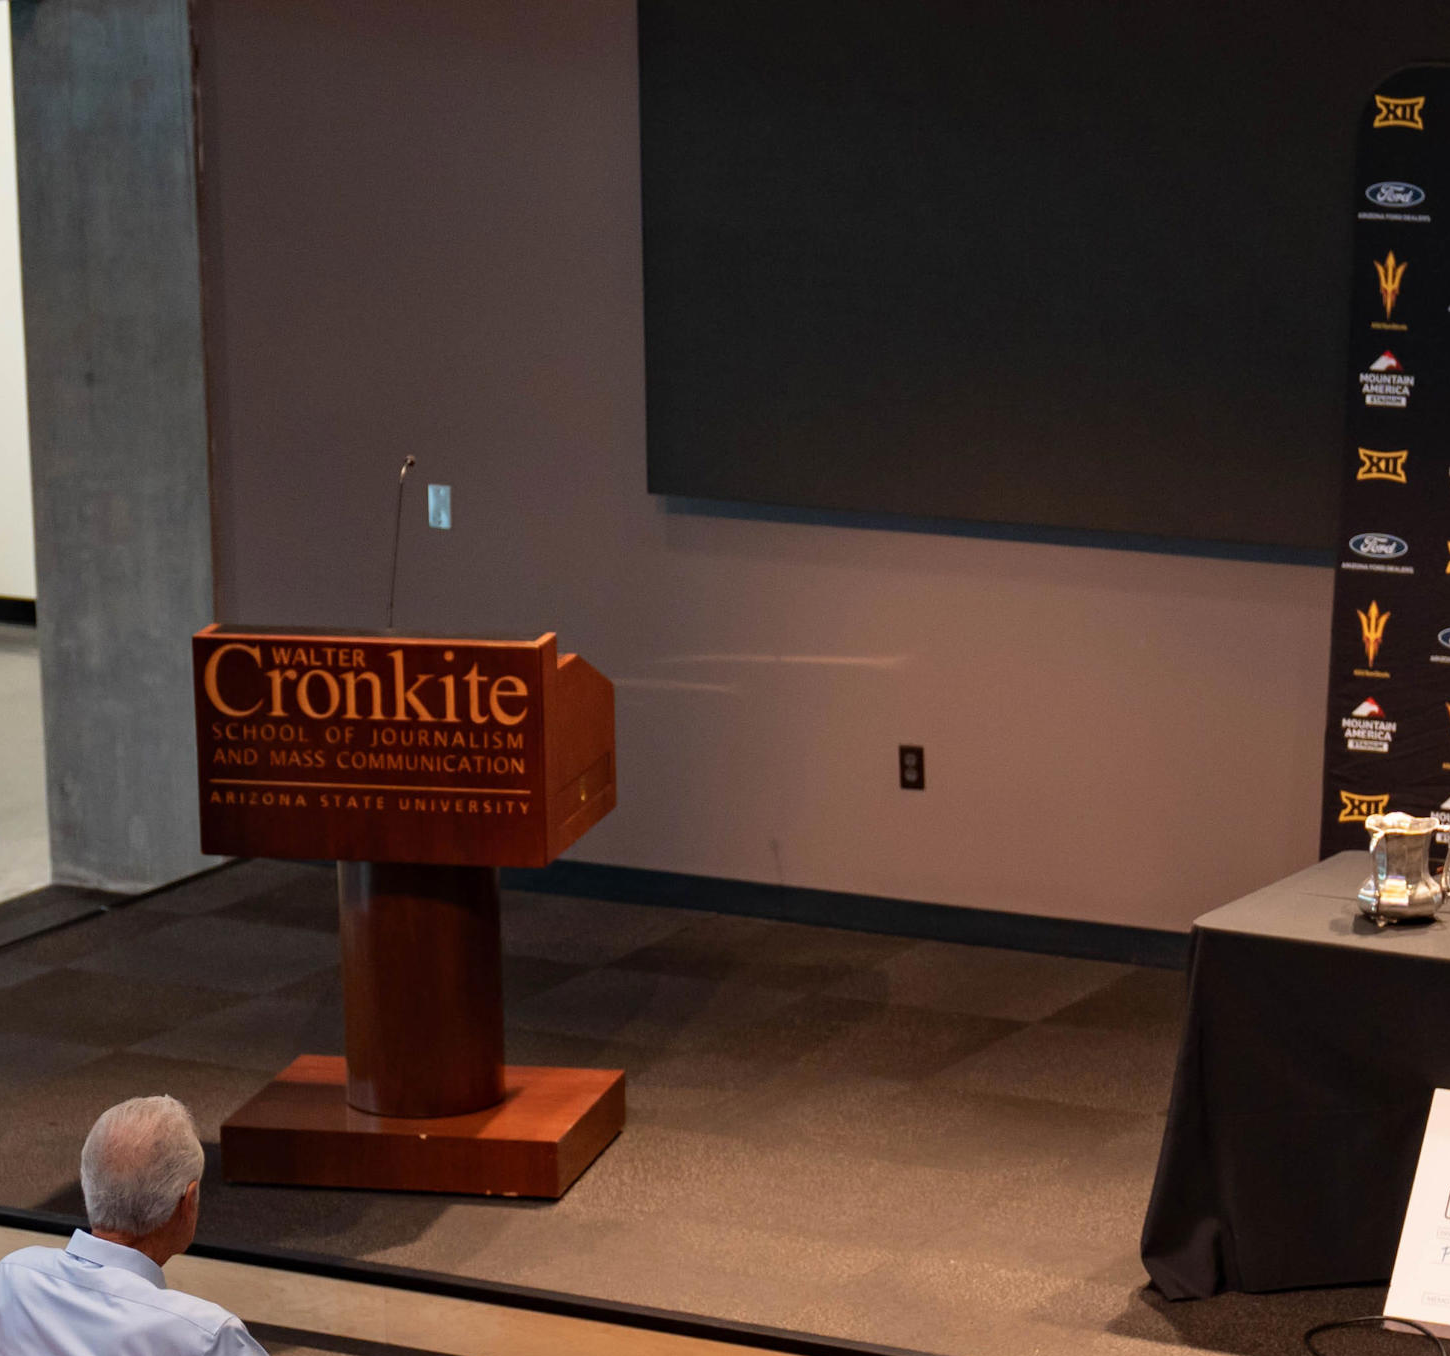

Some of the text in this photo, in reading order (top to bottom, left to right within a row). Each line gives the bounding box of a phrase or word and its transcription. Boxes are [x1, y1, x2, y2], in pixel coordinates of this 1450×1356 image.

[272, 647, 366, 668] WALTER
[205, 643, 529, 726] Cronkite
[211, 722, 525, 750] SCHOOL OF JOURNALISM
[213, 748, 525, 775] AND MASS COMMUNICATION
[209, 790, 530, 816] ARIZONA STATE UNIVERSITY
